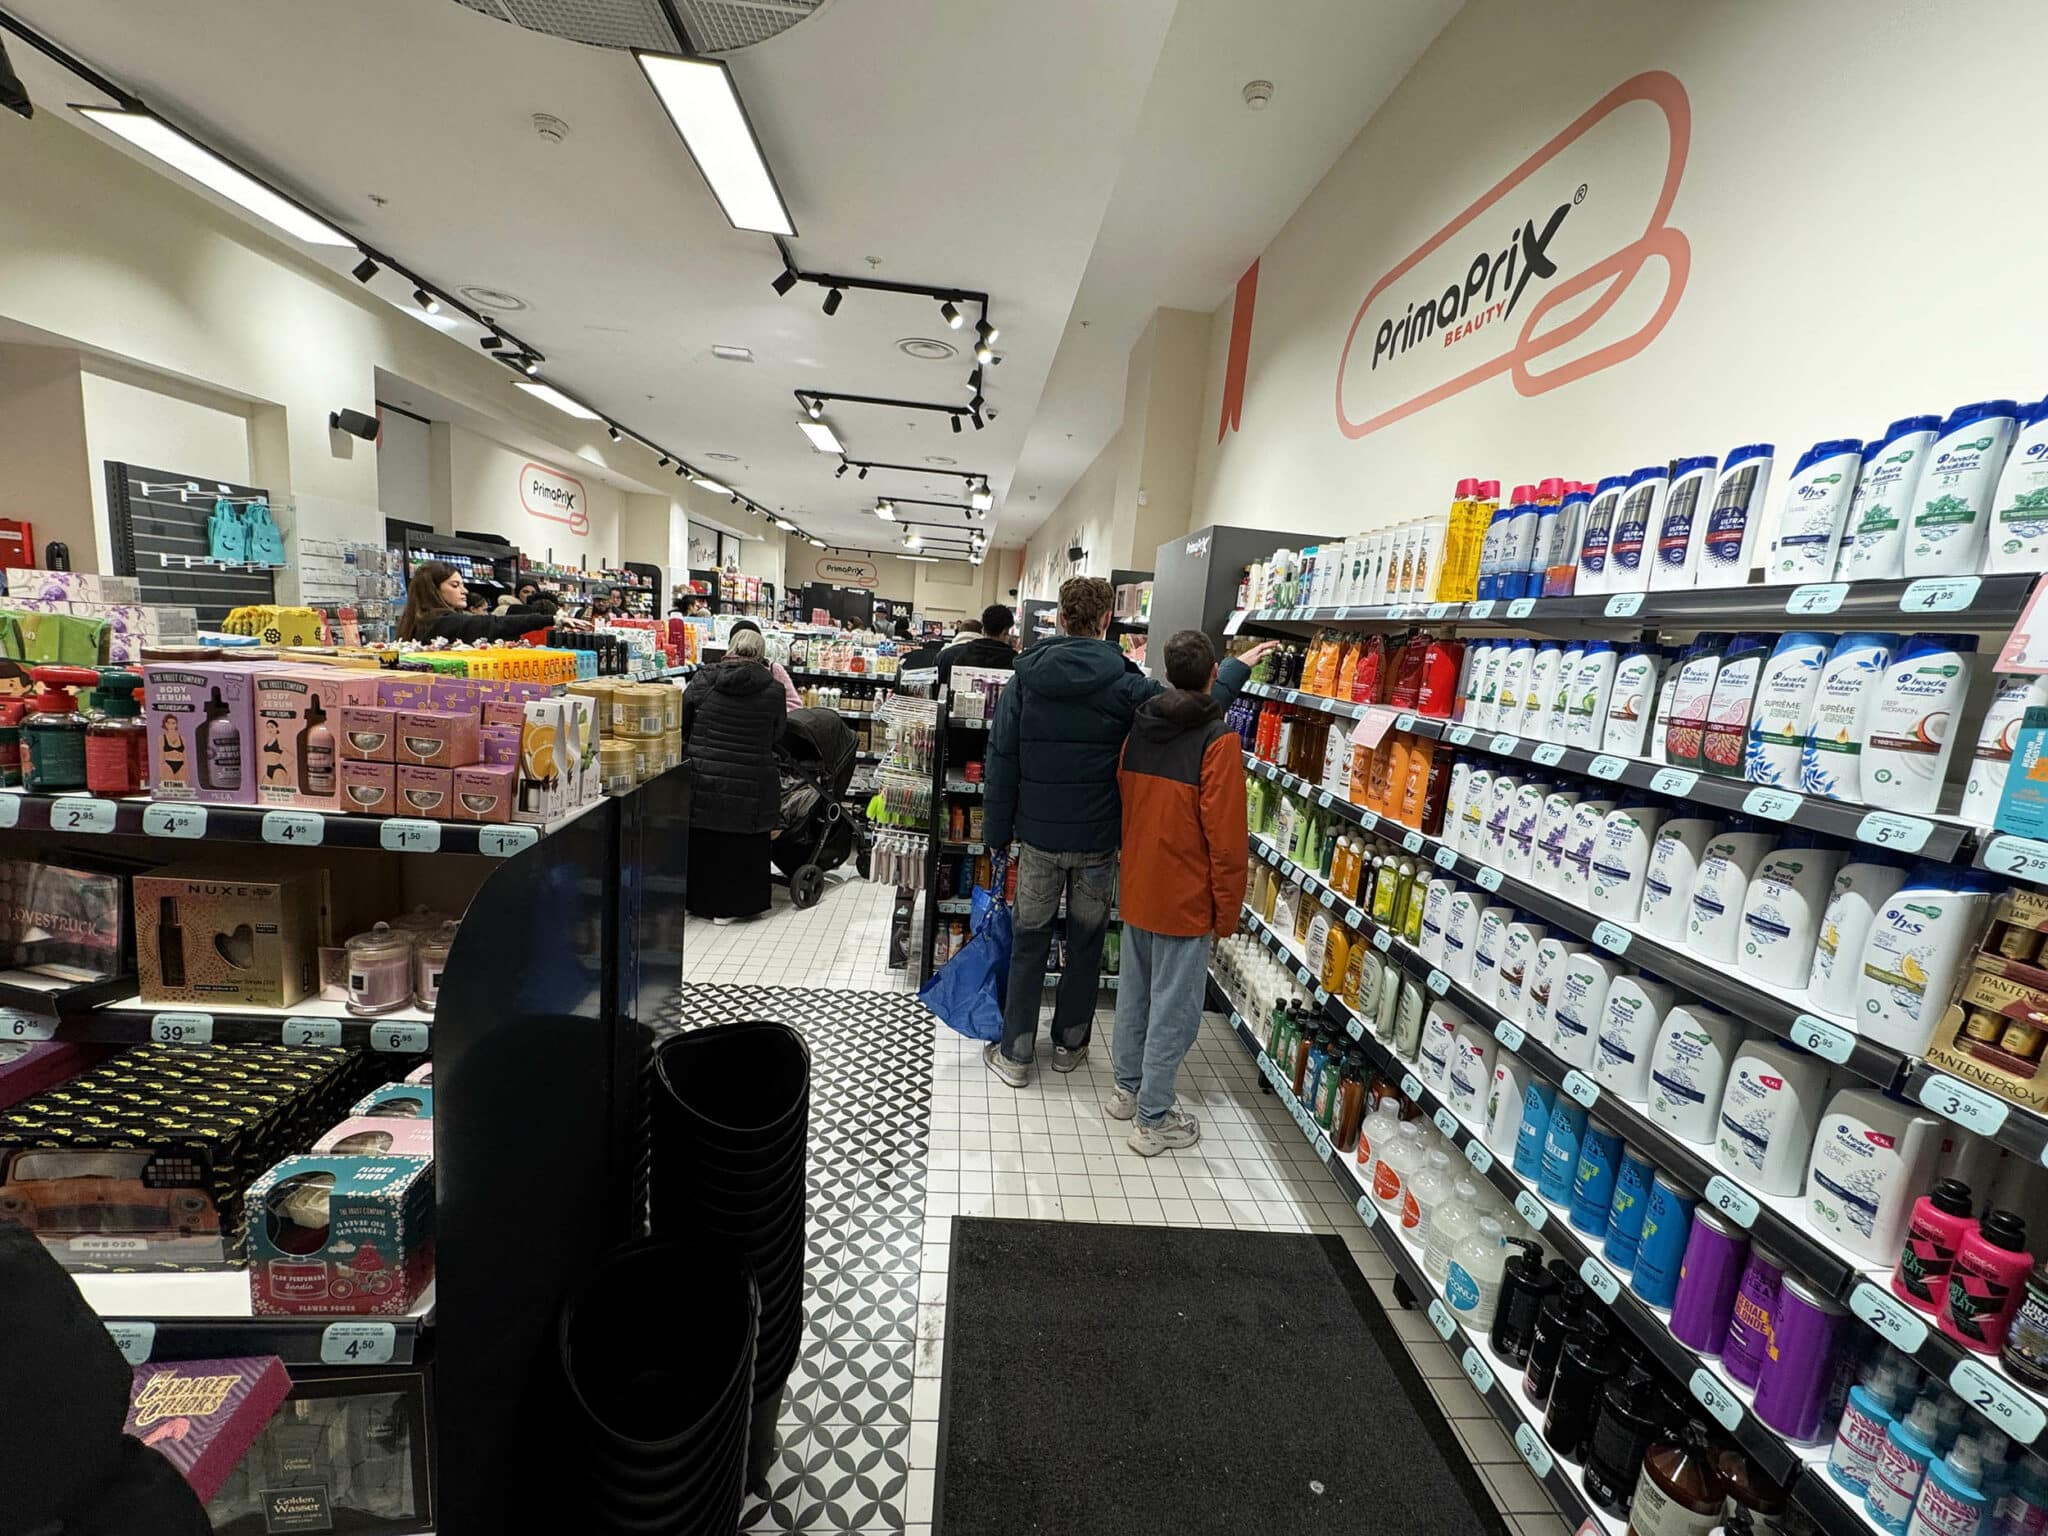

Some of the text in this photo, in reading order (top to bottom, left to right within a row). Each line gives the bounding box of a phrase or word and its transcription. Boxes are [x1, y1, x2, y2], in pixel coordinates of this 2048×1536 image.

[1444, 300, 1507, 348] BEAUTY
[1669, 524, 1690, 533] ULTRA
[1720, 516, 1745, 526] ULTRA
[1624, 529, 1644, 538] ULTRA
[1802, 596, 1829, 611] 4.95
[1922, 591, 1954, 608] 4.95
[156, 693, 192, 702] SERUM
[159, 686, 186, 694] BODY
[1895, 685, 1946, 695] shoulders
[262, 700, 293, 708] SERUM
[1820, 703, 1857, 714] SUPRÊME
[1758, 800, 1783, 813] 5.35
[69, 811, 94, 827] 2.95
[163, 817, 189, 833] 4.95
[282, 821, 306, 840] 4.95
[1876, 827, 1907, 842] 5.35
[397, 831, 421, 847] 1.50
[496, 838, 519, 853] 1.95
[2007, 855, 2046, 874] 2.95
[188, 884, 249, 897] NUXE
[1981, 975, 2043, 1003] PANTENE
[1975, 991, 1996, 1004] LANG
[13, 1019, 39, 1035] 6.45
[160, 1025, 196, 1041] 39.95
[302, 1030, 325, 1045] 2.95
[390, 1034, 412, 1048] 6.95
[1807, 1034, 1833, 1050] 6.95
[1765, 1078, 1779, 1089] XXL
[1943, 1098, 1979, 1118] 3.95
[1873, 1134, 1890, 1147] XXL
[353, 1173, 387, 1181] POWER
[358, 1166, 396, 1174] FLOWER
[1719, 1195, 1741, 1212] 8.95
[112, 1240, 137, 1248] 020
[299, 1304, 356, 1312] FLOWER POWER
[1868, 1308, 1902, 1333] 2.95
[344, 1339, 375, 1359] 4.50
[1703, 1391, 1726, 1412] 9.95
[1971, 1390, 2013, 1418] 2.50
[1850, 1420, 1886, 1450] FRIZ
[276, 1496, 315, 1505] Golden
[273, 1503, 320, 1514] Wasser
[1923, 1491, 1976, 1532] FRIZZ
